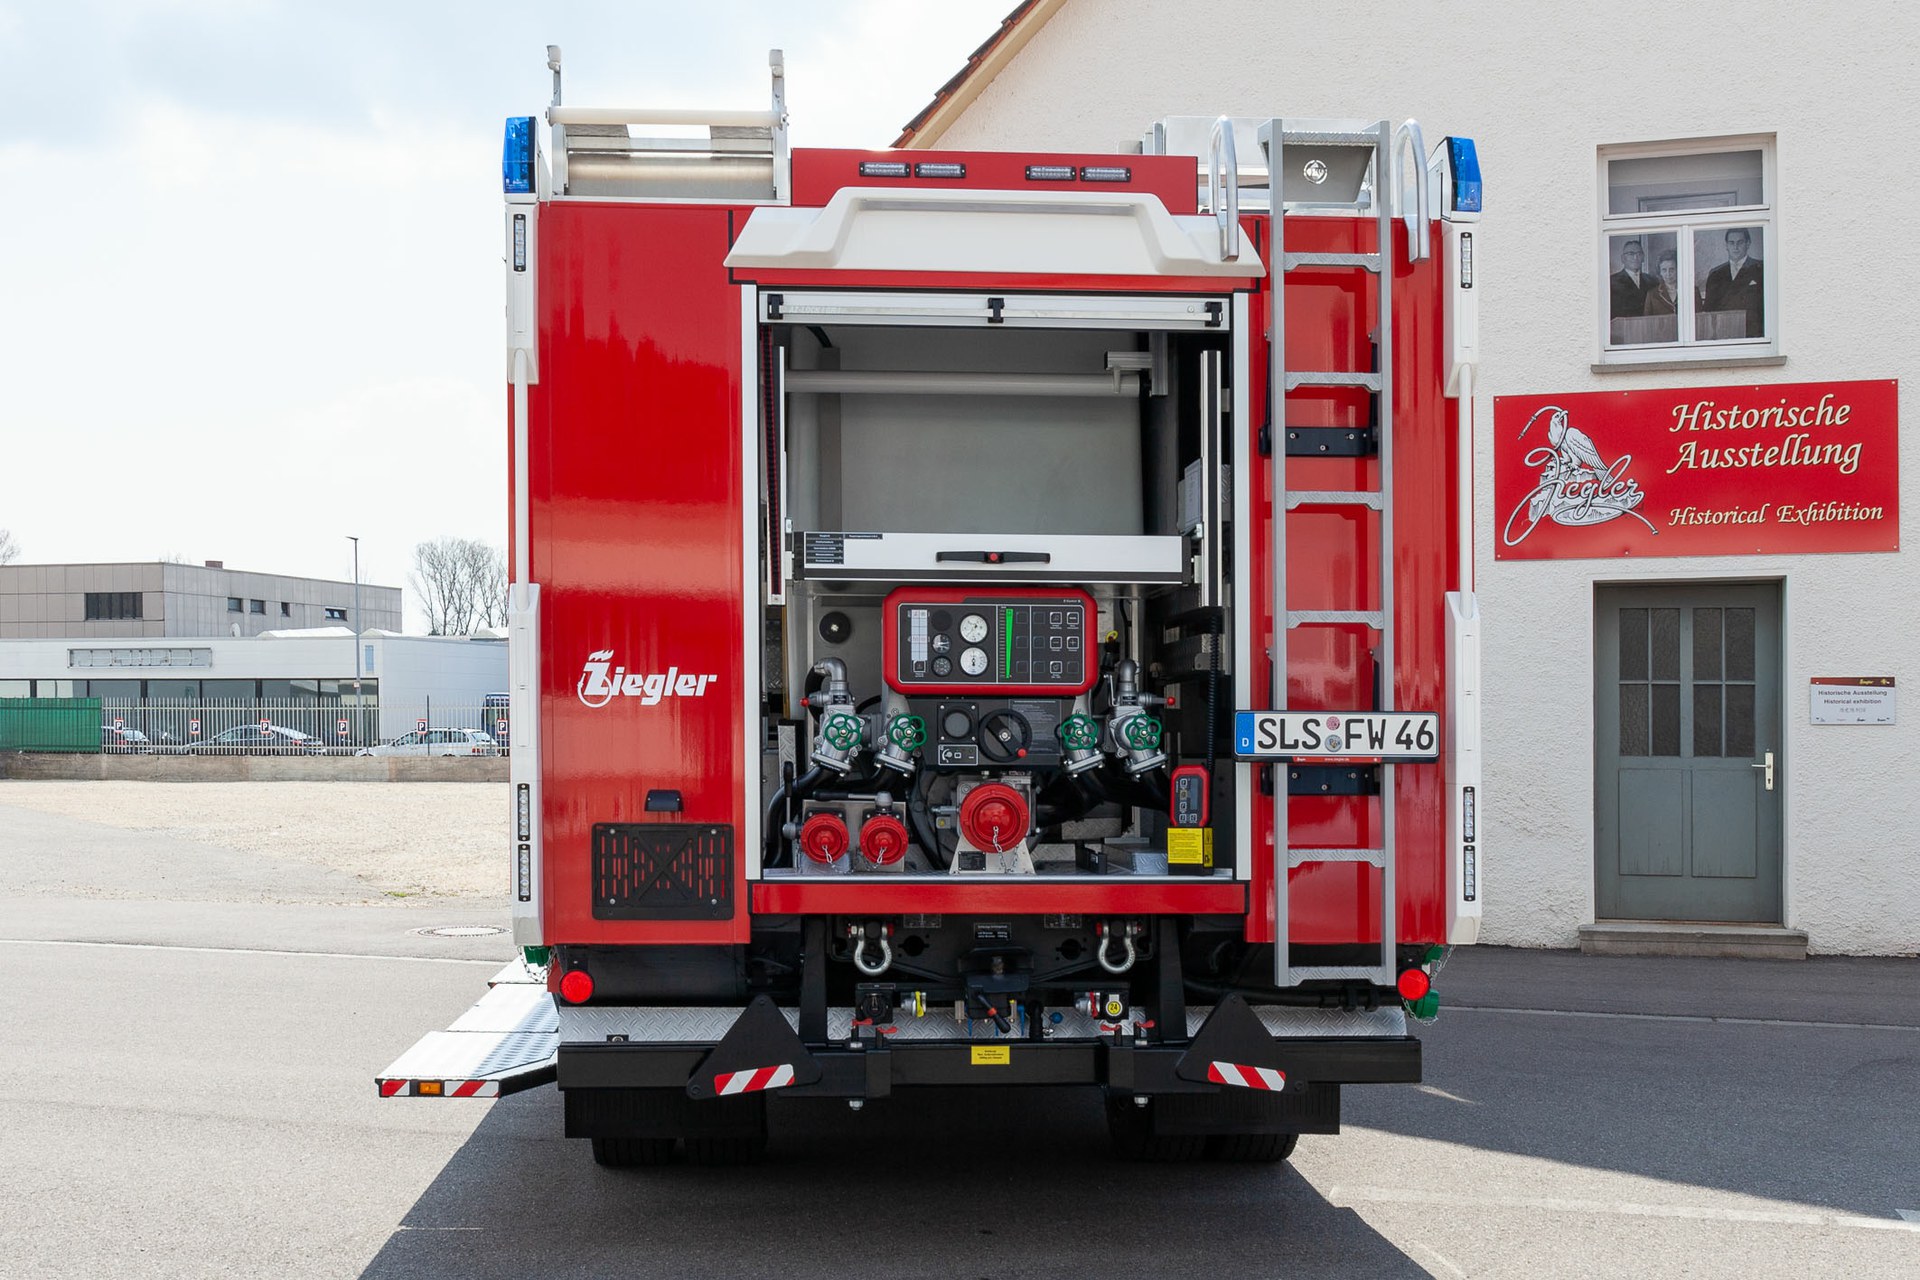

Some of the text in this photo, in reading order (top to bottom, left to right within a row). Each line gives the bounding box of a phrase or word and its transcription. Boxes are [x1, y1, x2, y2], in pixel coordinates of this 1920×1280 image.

[1668, 393, 1851, 433] Historische
[1666, 434, 1862, 475] Ausstellung
[1668, 501, 1884, 527] Historical Exhibition
[577, 655, 718, 708] Ziegler
[1241, 737, 1249, 747] D
[1257, 717, 1434, 750] SLS FW 46
[1110, 1003, 1118, 1011] 24
